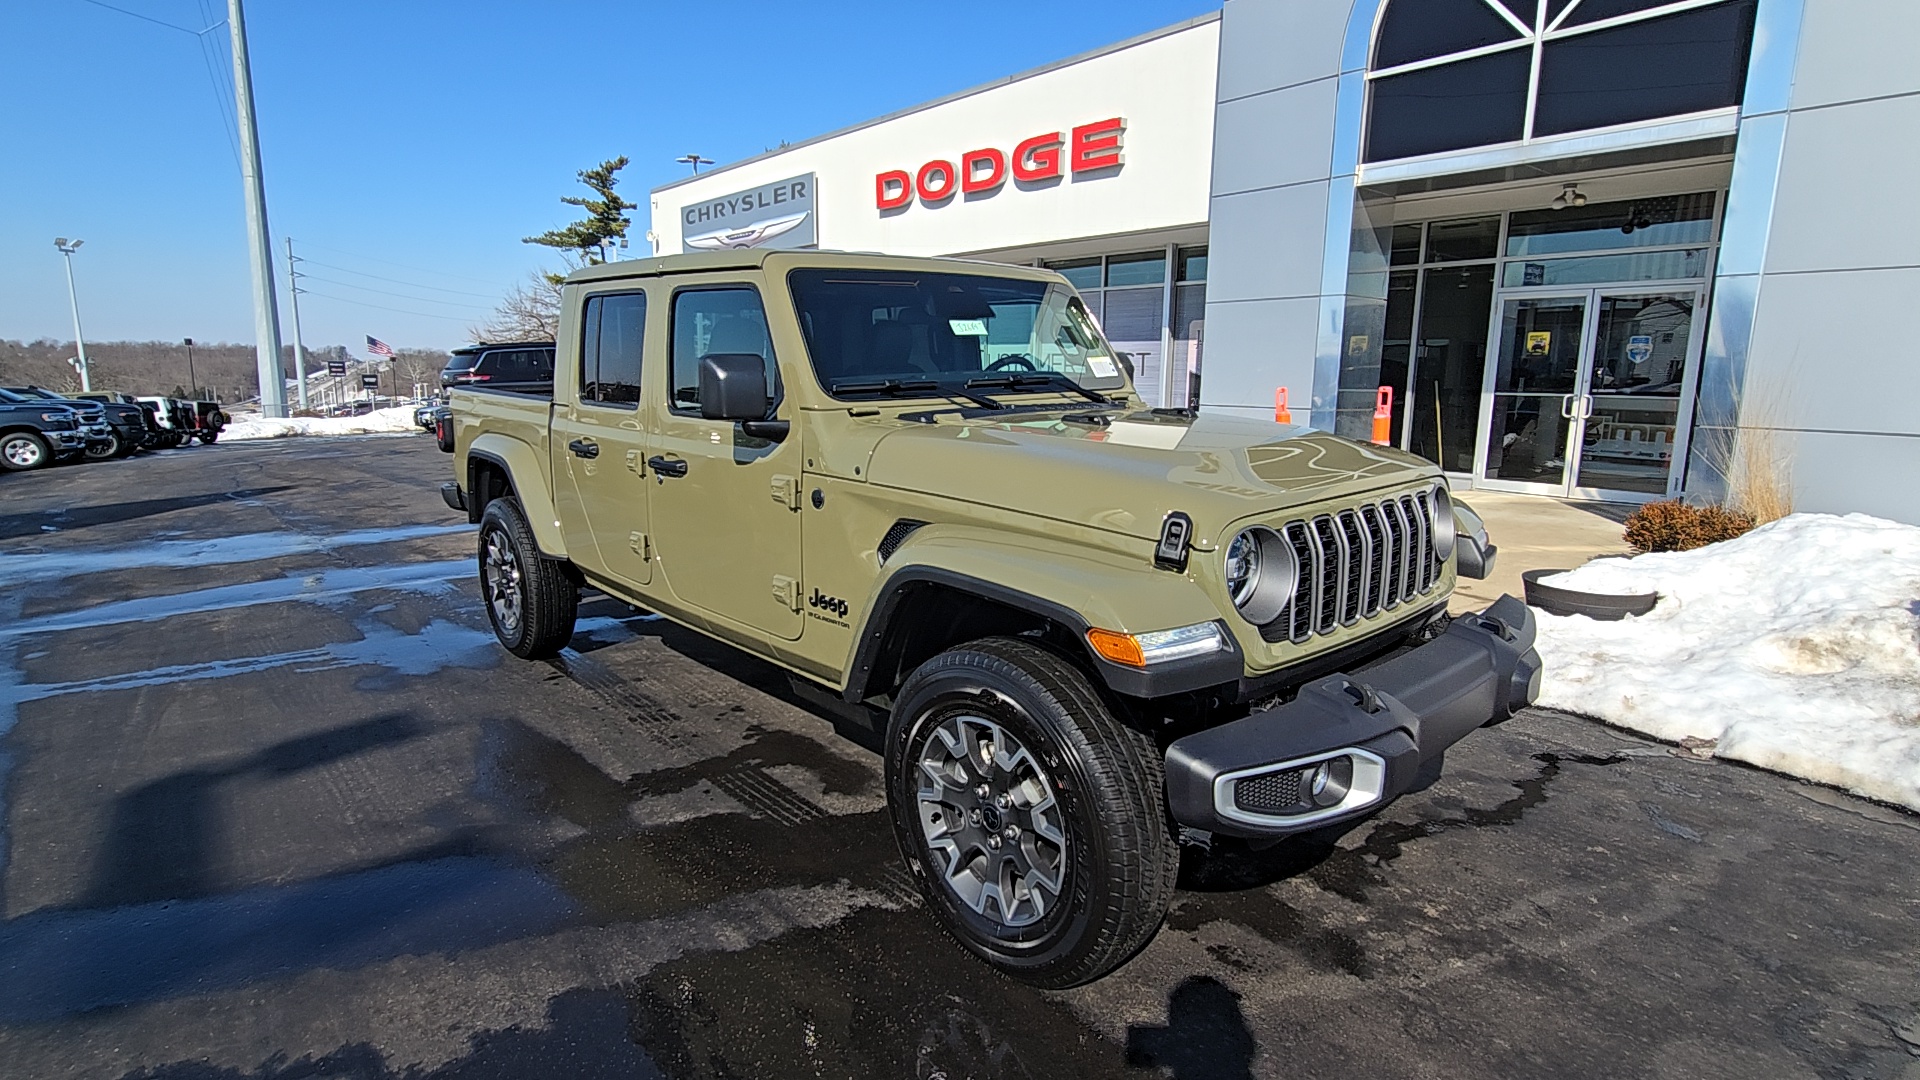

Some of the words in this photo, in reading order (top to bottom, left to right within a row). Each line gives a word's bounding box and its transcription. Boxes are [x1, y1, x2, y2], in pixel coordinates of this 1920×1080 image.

[875, 117, 1127, 211] DODGE
[685, 181, 806, 225] CHRYSLER
[808, 587, 849, 619] Jeep
[813, 612, 850, 630] GLADIATOR
